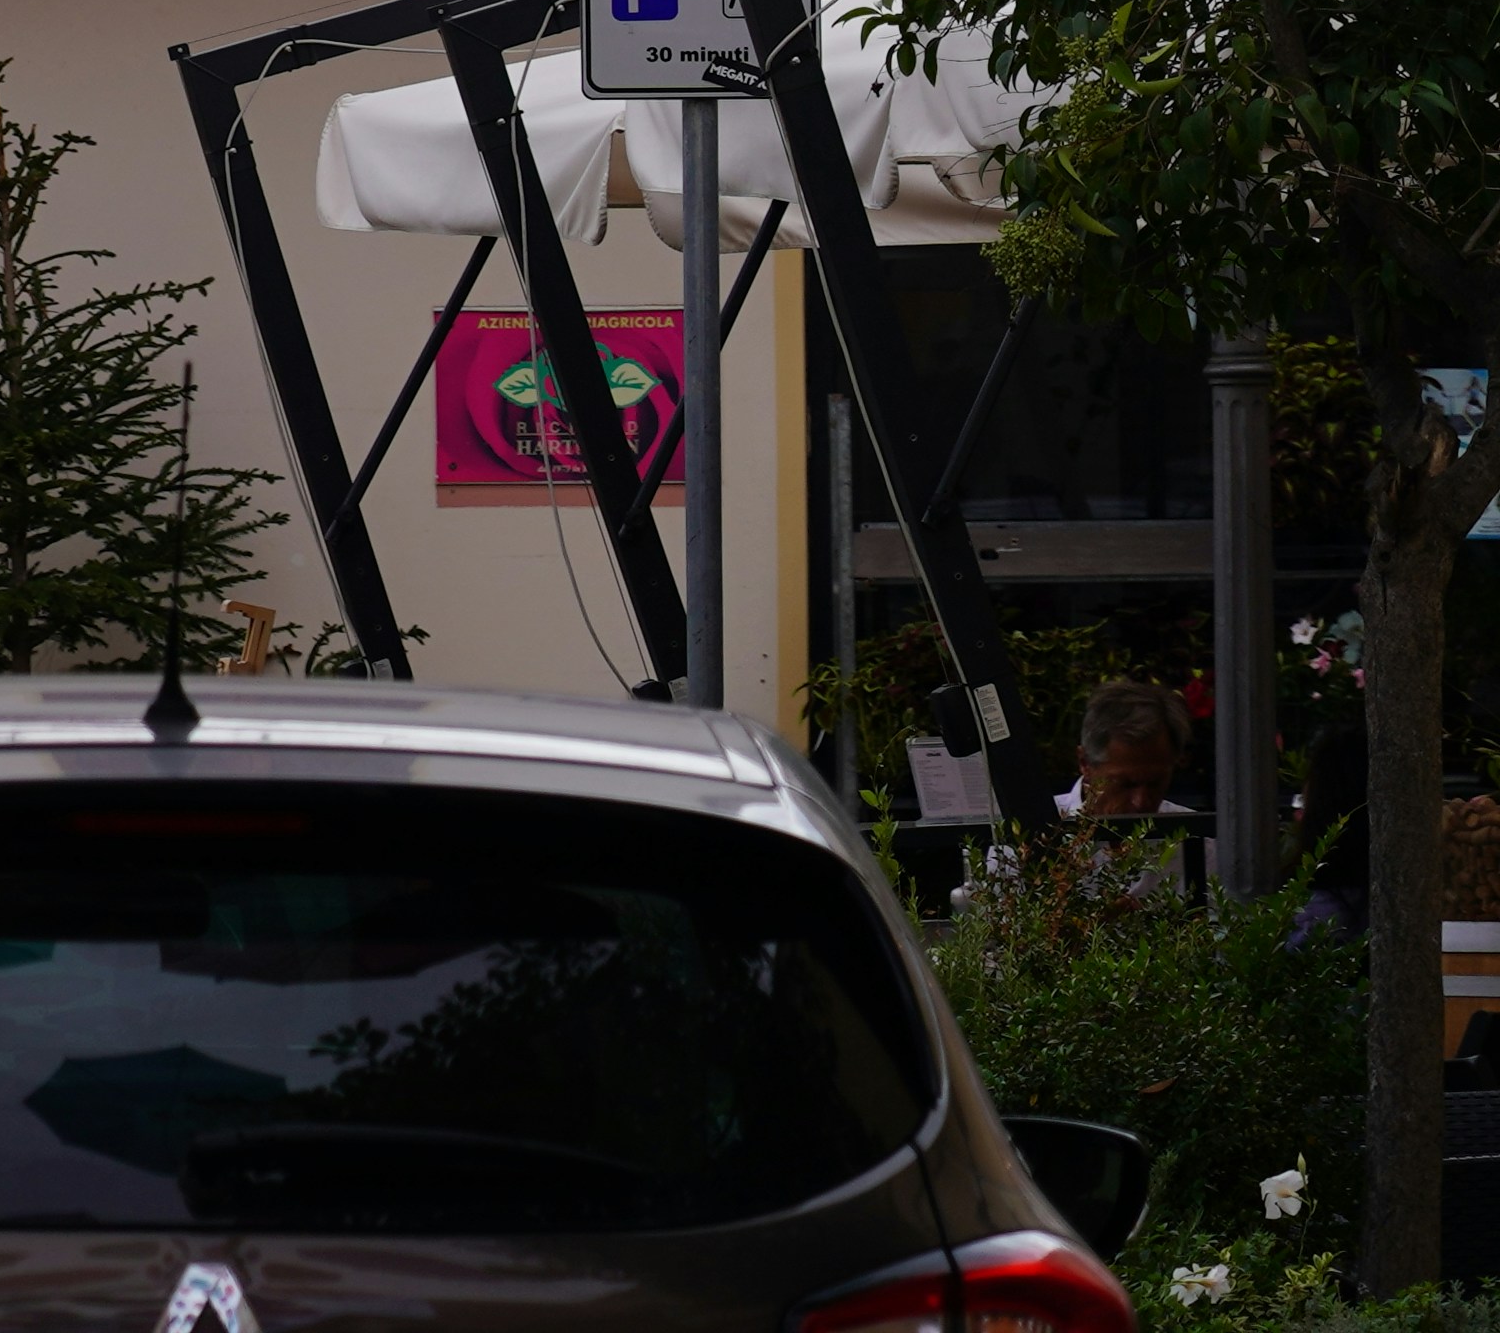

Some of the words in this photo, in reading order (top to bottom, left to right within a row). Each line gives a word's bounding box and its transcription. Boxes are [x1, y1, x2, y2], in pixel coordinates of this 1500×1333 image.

[646, 46, 673, 63] 30
[680, 46, 749, 63] minuti
[476, 317, 541, 330] AZIEND
